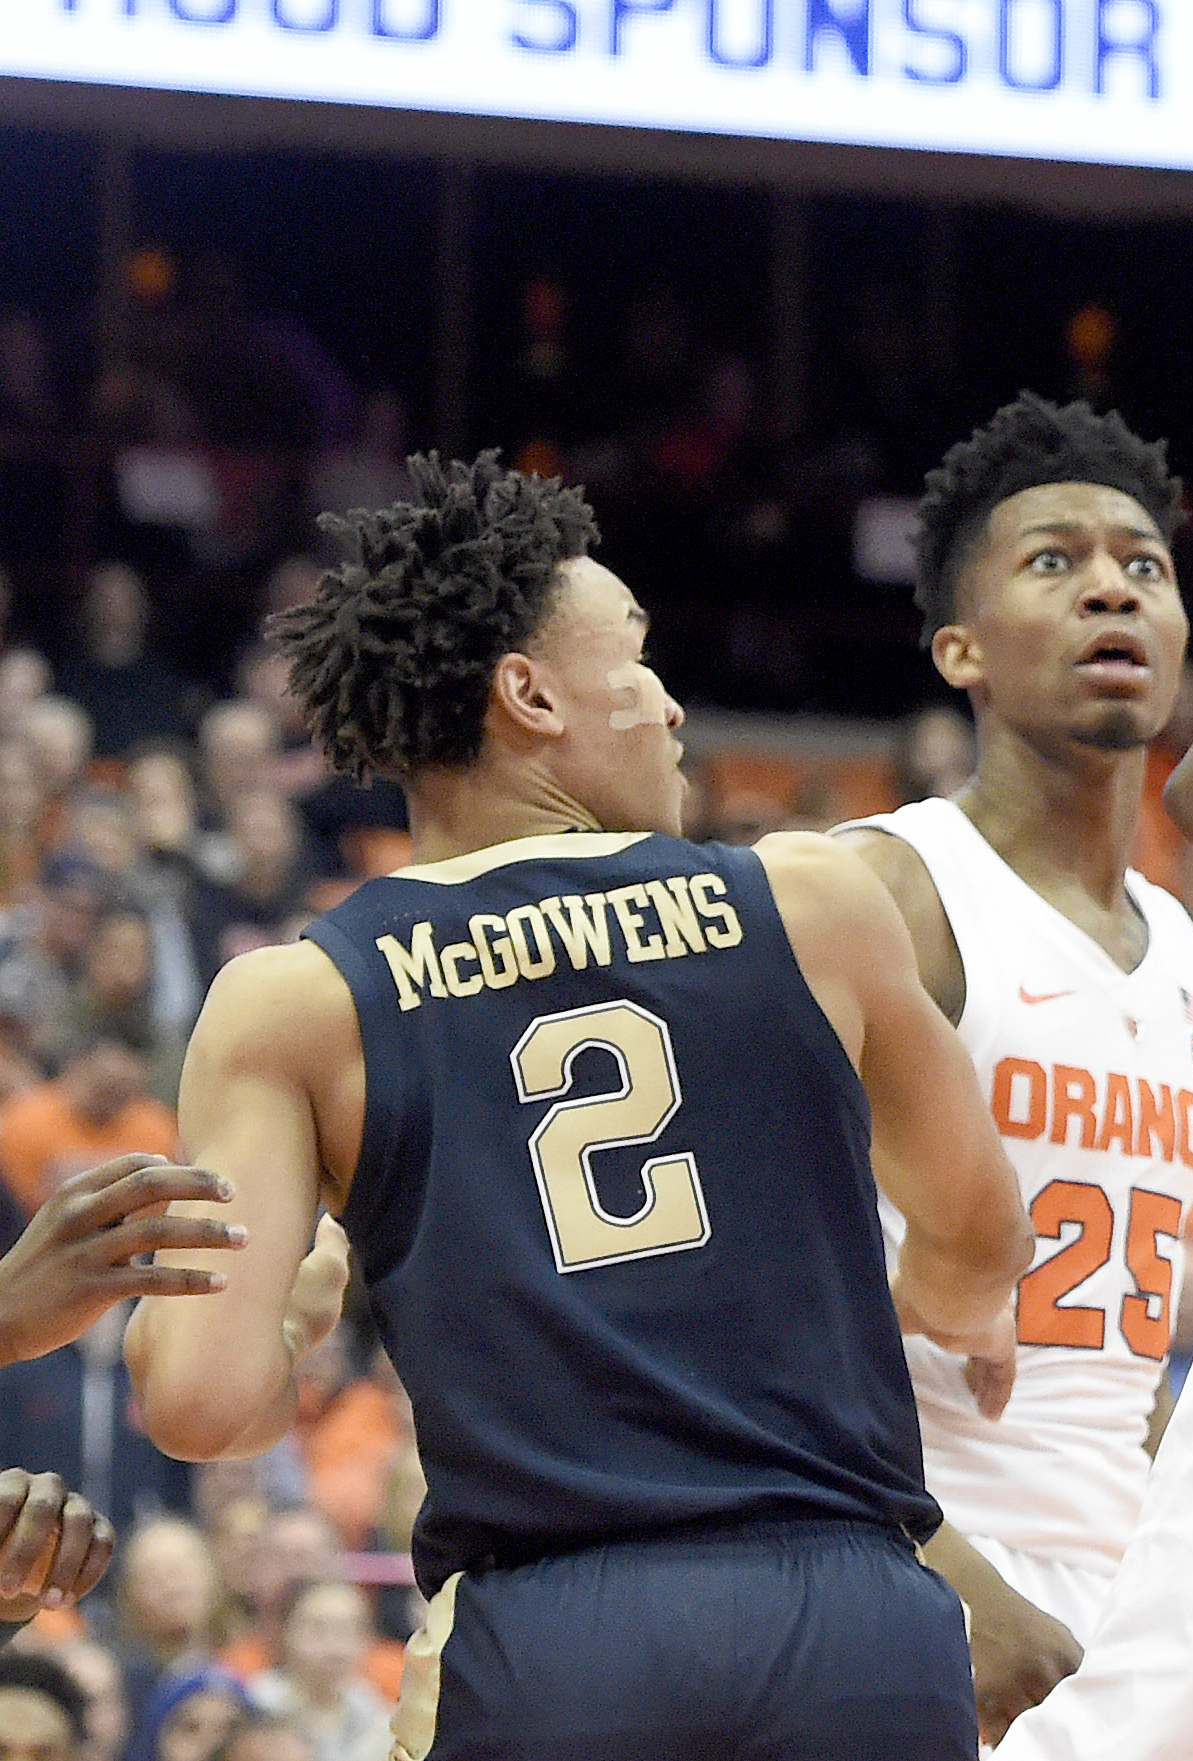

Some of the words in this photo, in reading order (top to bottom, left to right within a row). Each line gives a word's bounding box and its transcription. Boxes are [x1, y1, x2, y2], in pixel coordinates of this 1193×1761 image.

[376, 872, 742, 1012] McGOWENS
[509, 999, 712, 1274] 2
[1017, 1178, 1183, 1361] 25
